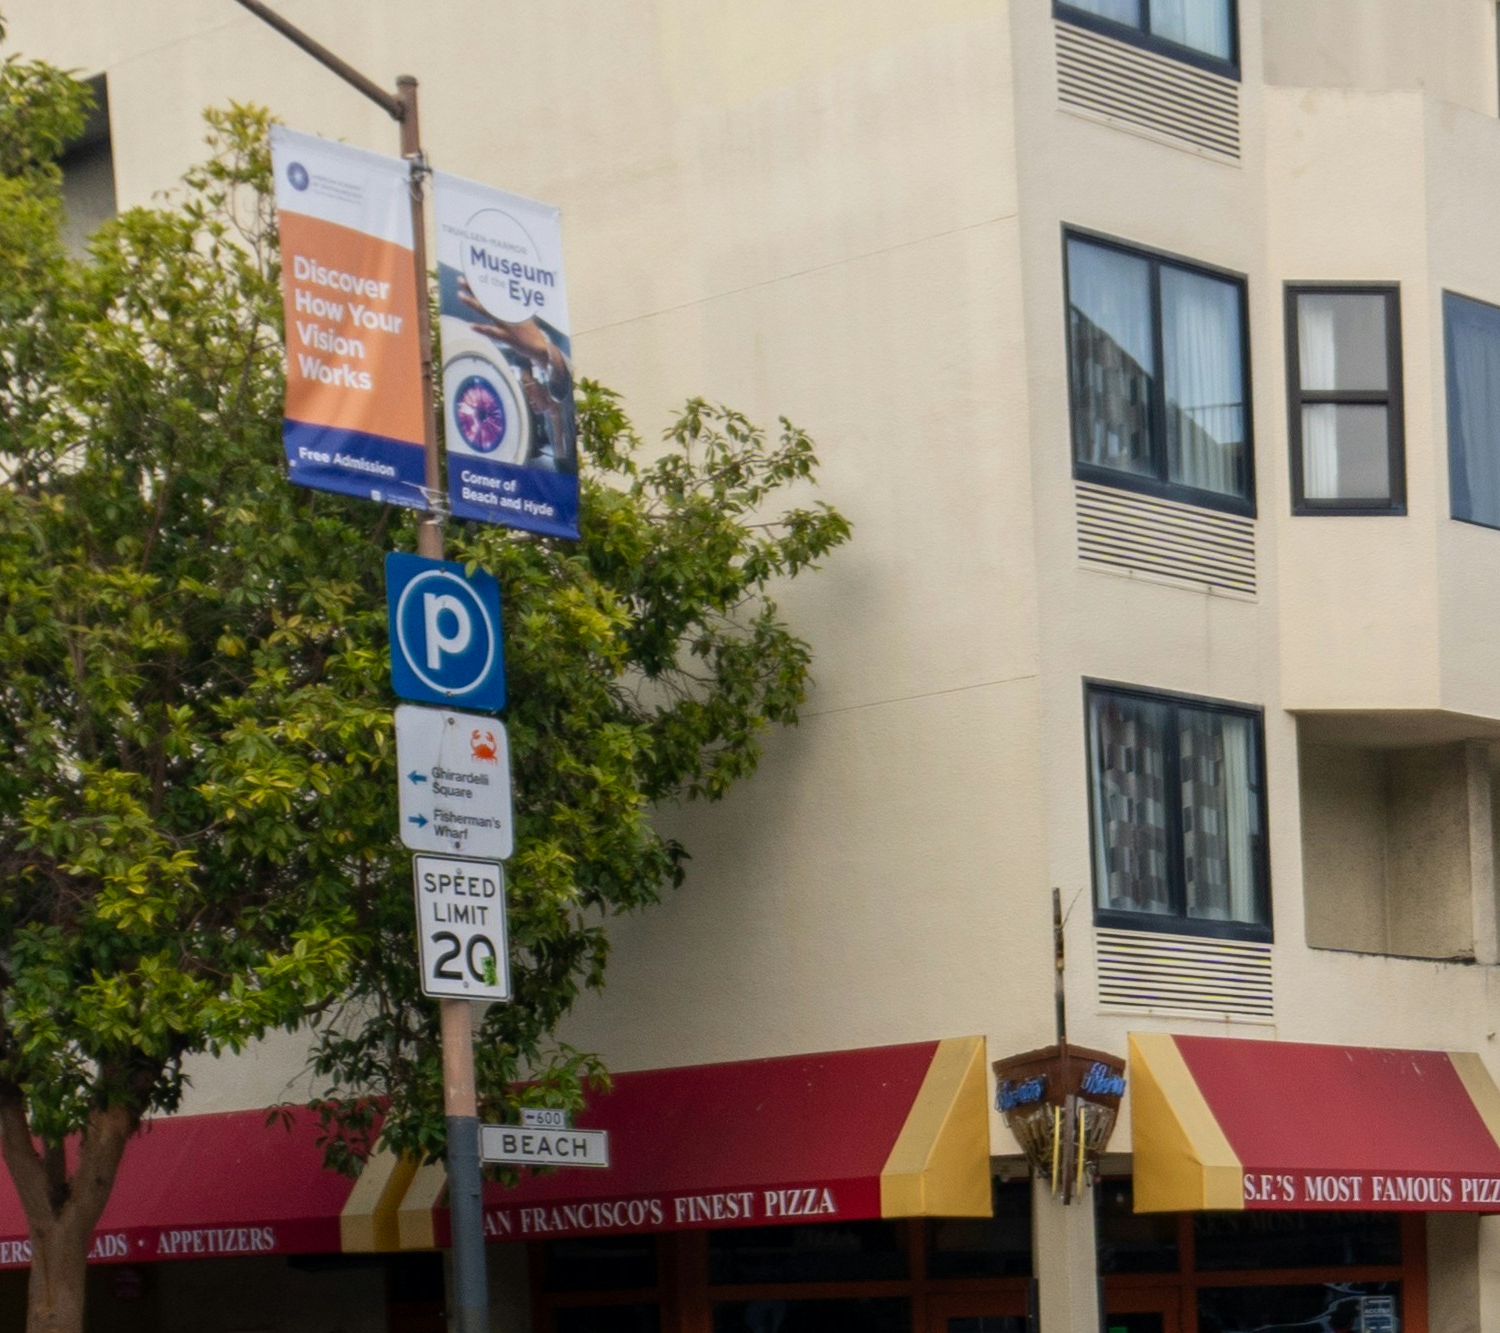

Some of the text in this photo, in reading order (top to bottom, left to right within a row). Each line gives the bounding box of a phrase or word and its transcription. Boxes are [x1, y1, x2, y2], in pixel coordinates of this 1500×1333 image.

[293, 254, 390, 300] Discover
[470, 245, 555, 287] Museum
[509, 278, 545, 307] Eye
[295, 287, 403, 334] How Your
[296, 320, 366, 359] Vision
[297, 352, 373, 390] Works
[298, 446, 396, 477] Free Admission
[461, 470, 517, 492] Corner of
[462, 487, 554, 516] Beach and Hyde
[431, 766, 490, 787] Ghirardelli
[432, 781, 473, 799] Square
[433, 809, 501, 830] Fisherman's
[433, 825, 469, 841] Wharf
[424, 872, 495, 898] SPEED
[433, 901, 488, 926] LIMIT
[430, 930, 497, 984] 20
[536, 1112, 562, 1126] 600
[503, 1134, 588, 1158] BEACH
[1243, 1173, 1296, 1201] S.F.'S
[1304, 1175, 1363, 1202] MOST
[1371, 1175, 1452, 1203] FAMOUS
[483, 1187, 837, 1237] AN FRANCISCO'S FINEST PIZZA
[156, 1226, 275, 1255] APPETIZERS
